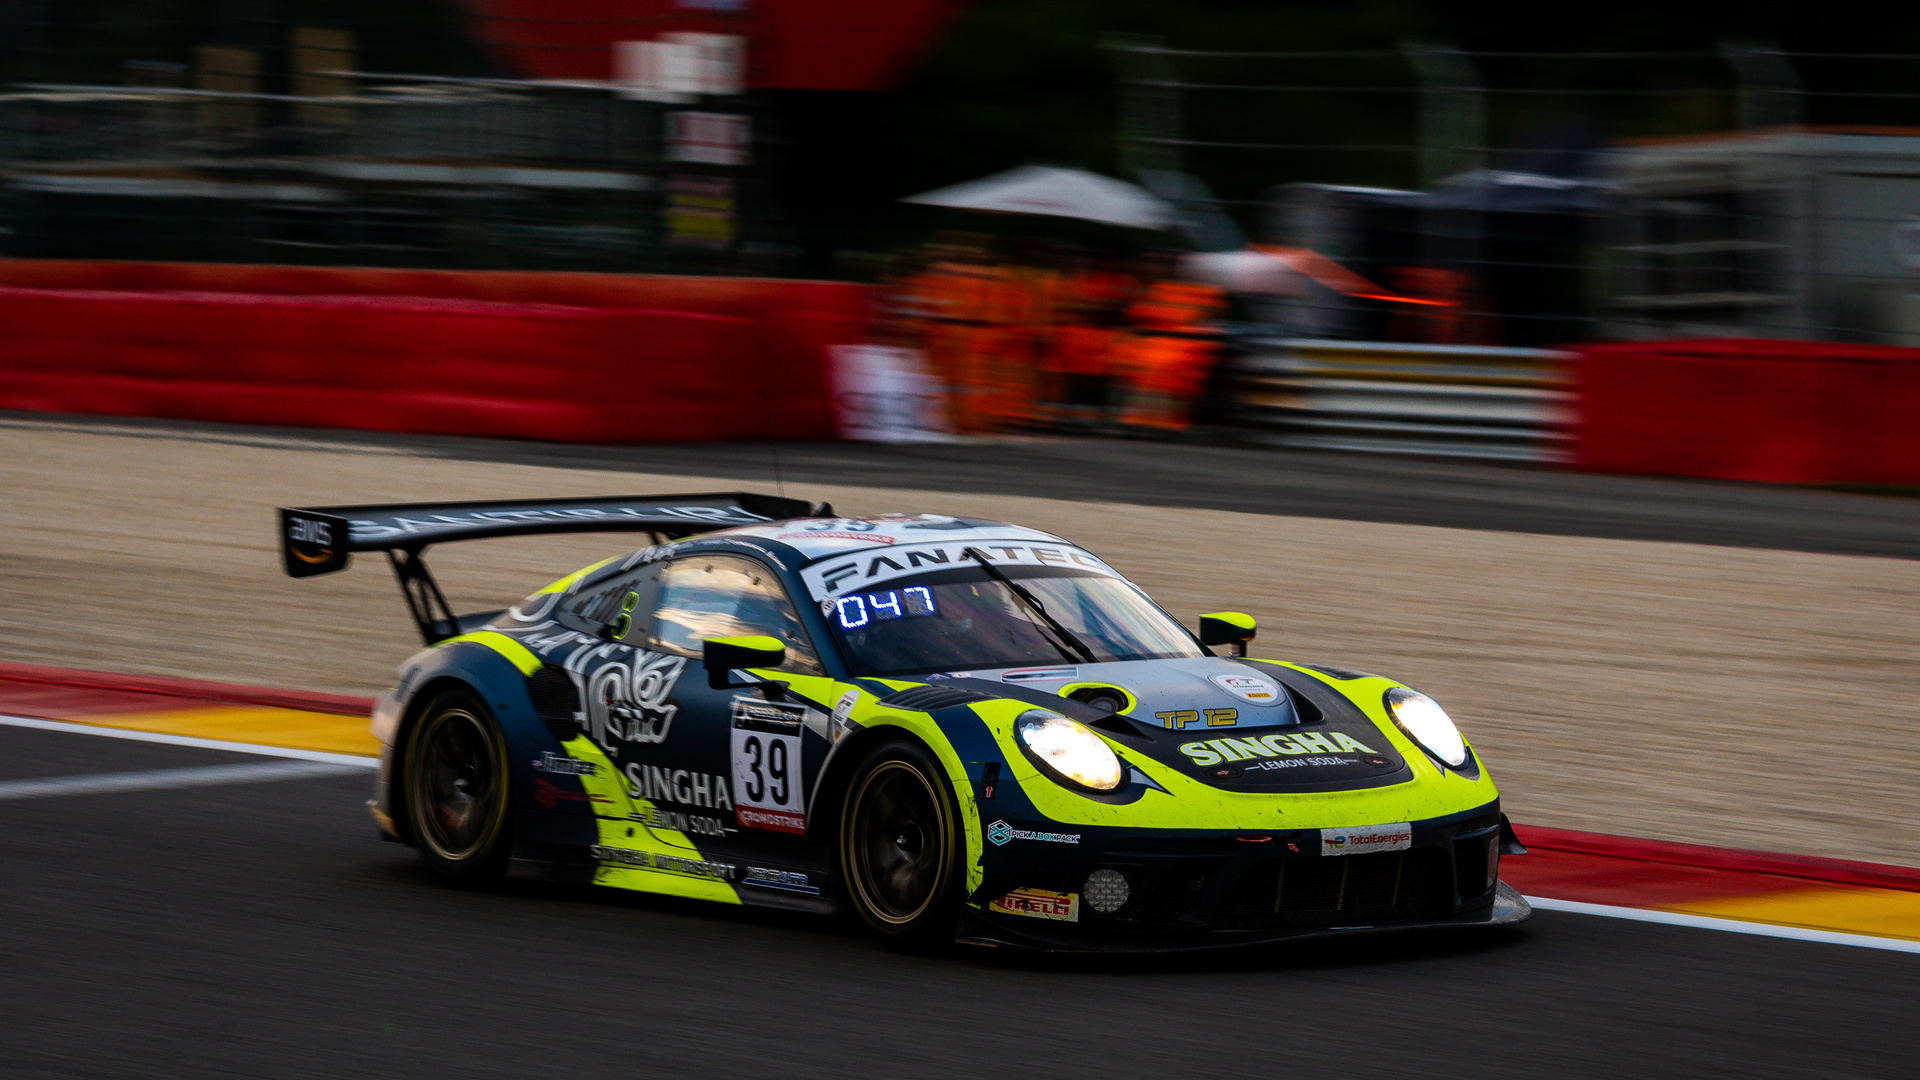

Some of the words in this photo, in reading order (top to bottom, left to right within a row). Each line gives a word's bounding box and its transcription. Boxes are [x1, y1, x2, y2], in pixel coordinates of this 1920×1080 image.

[821, 545, 1106, 593] FANATEC
[836, 586, 935, 628] 047
[1155, 709, 1199, 729] TP
[1203, 708, 1238, 727] 12
[1179, 731, 1379, 767] SINGHA
[1258, 758, 1306, 771] LEMON
[1306, 756, 1346, 767] SODA
[744, 735, 790, 806] 39
[625, 762, 735, 811] SINGHA
[689, 814, 727, 838] SODA
[740, 810, 806, 830] CROWDSTRIKE
[1348, 832, 1411, 845] TotalEnergies
